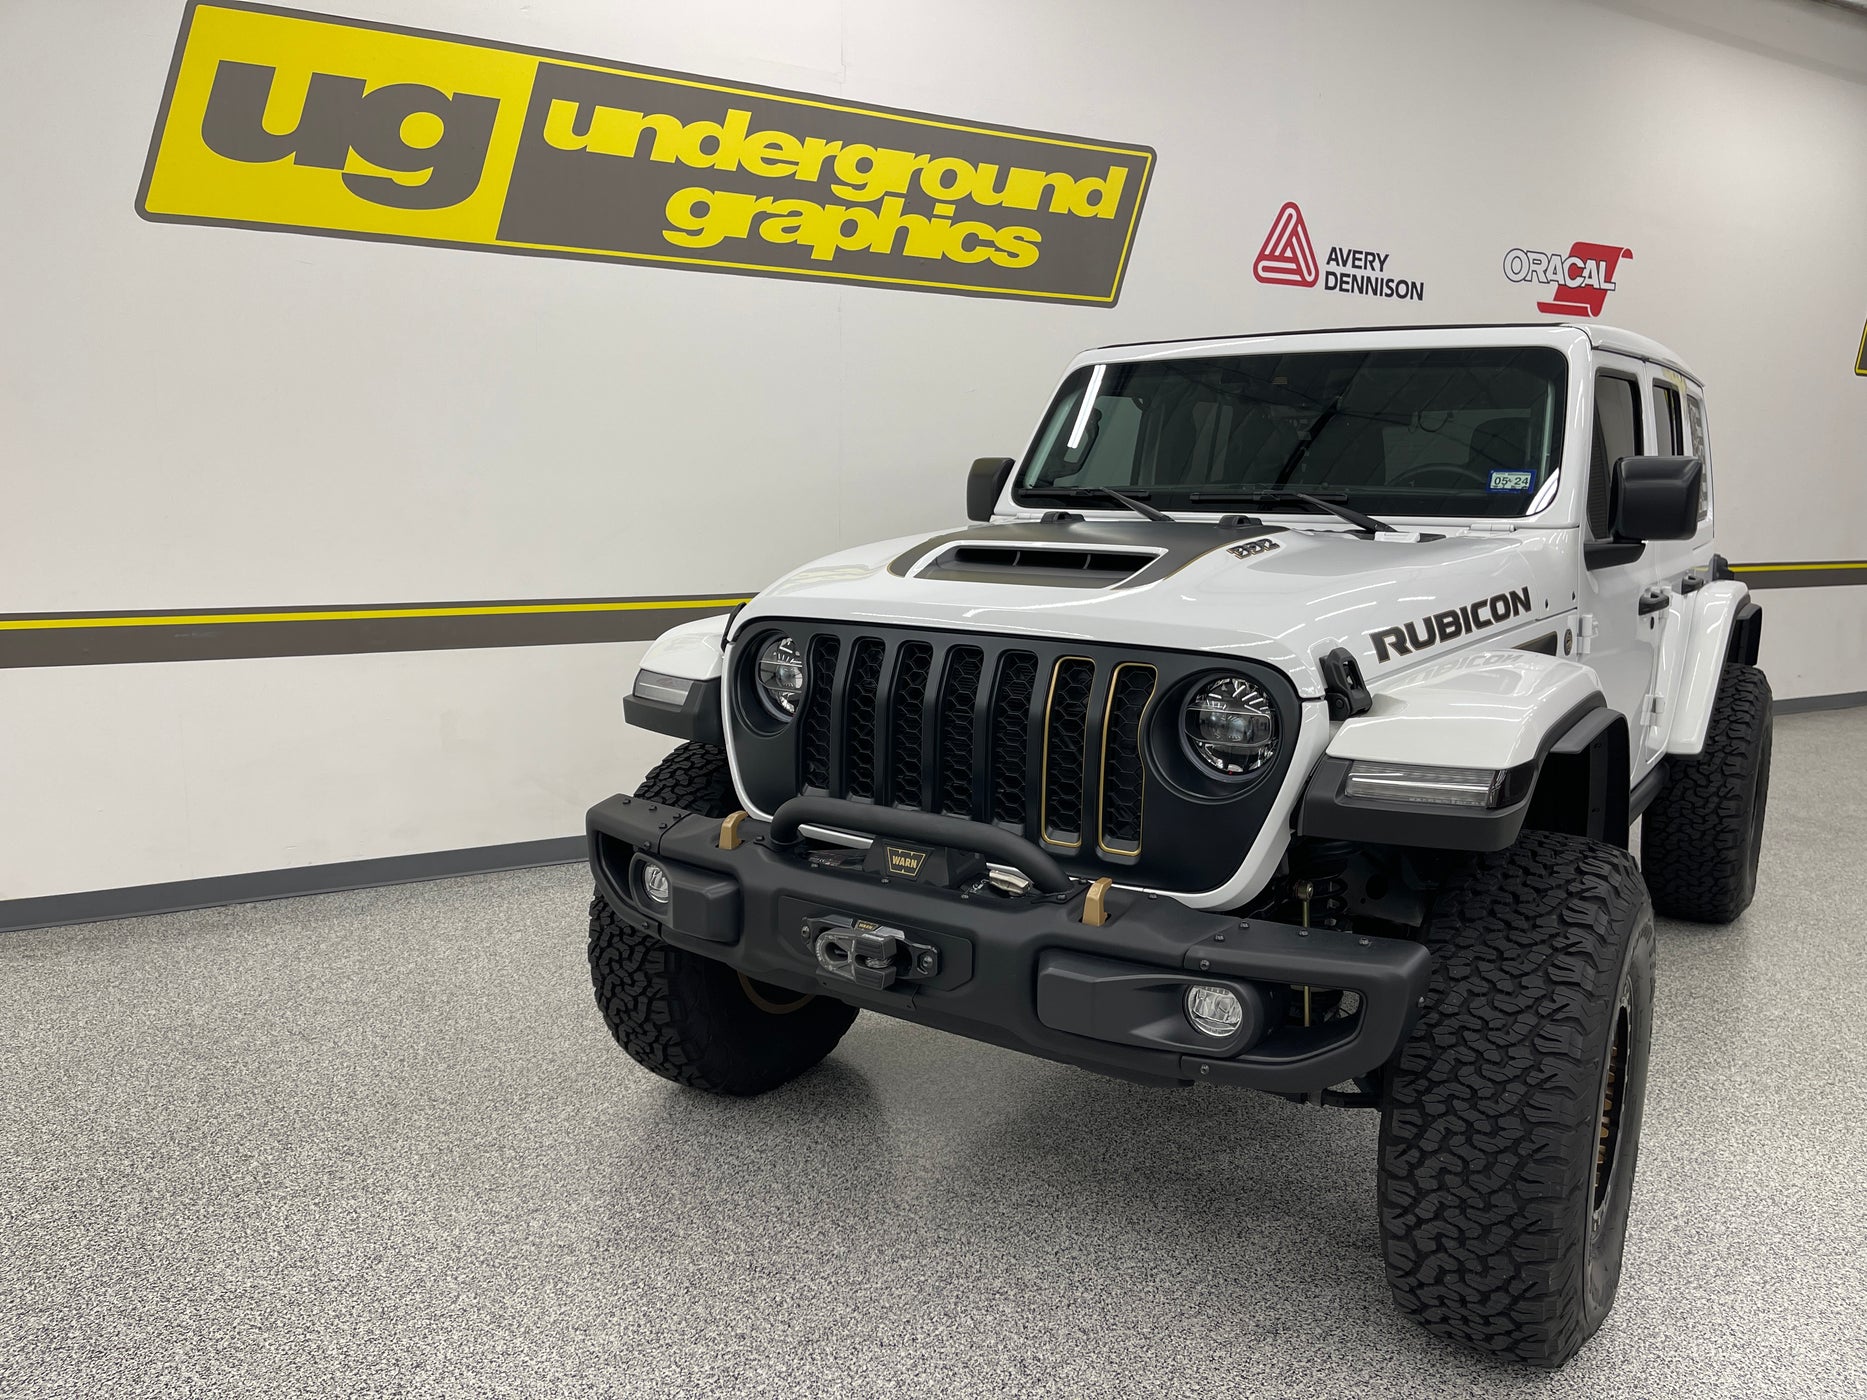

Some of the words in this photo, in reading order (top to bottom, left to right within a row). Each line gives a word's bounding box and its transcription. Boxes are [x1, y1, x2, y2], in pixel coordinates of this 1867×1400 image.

[201, 59, 500, 211] ug
[543, 98, 1128, 220] underground
[662, 186, 1042, 269] graphics
[1326, 246, 1389, 273] AVERY
[1503, 248, 1616, 291] ORACAL
[1324, 271, 1425, 301] DENNISON
[1494, 476, 1508, 486] 05
[1514, 476, 1529, 486] 24
[1369, 586, 1532, 664] RUBICON
[892, 855, 918, 869] WARN
